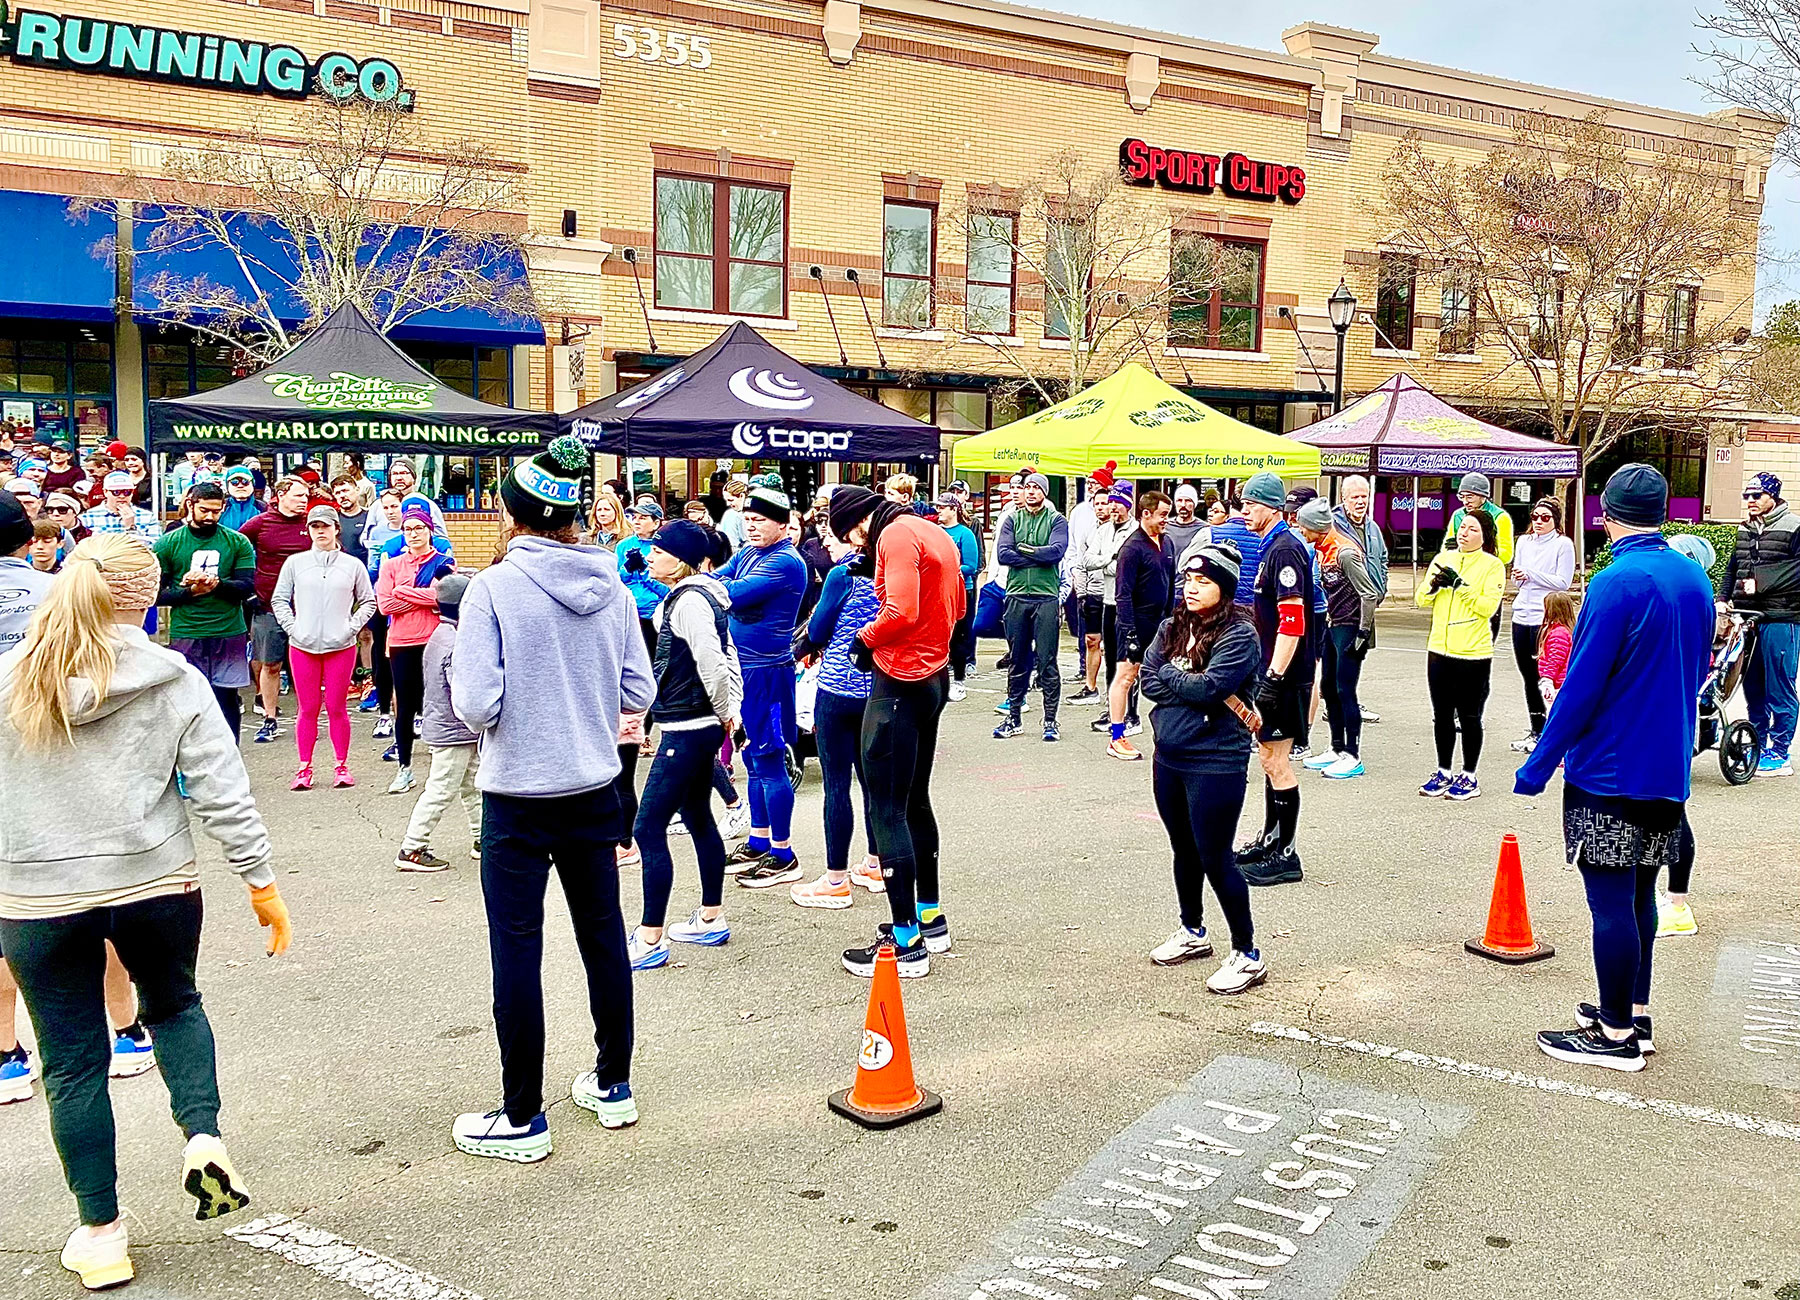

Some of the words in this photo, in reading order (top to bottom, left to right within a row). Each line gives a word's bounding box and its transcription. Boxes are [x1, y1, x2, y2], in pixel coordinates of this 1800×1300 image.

[613, 23, 713, 70] 5355
[318, 54, 411, 106] CO.
[1127, 140, 1220, 188] SPORT
[1230, 155, 1306, 199] CLIPS
[263, 371, 438, 401] Charlotte
[306, 389, 433, 409] Running
[172, 421, 540, 445] www.CHARLOTTERUNNING.com
[767, 425, 850, 452] topo
[1128, 453, 1176, 468] Preparing
[1178, 454, 1202, 468] Boys
[1205, 454, 1220, 465] for
[1222, 455, 1238, 466] the
[1241, 455, 1264, 469] Long
[1266, 454, 1286, 466] Run
[538, 479, 561, 499] CO.
[1131, 1107, 1405, 1300] CUSTOM
